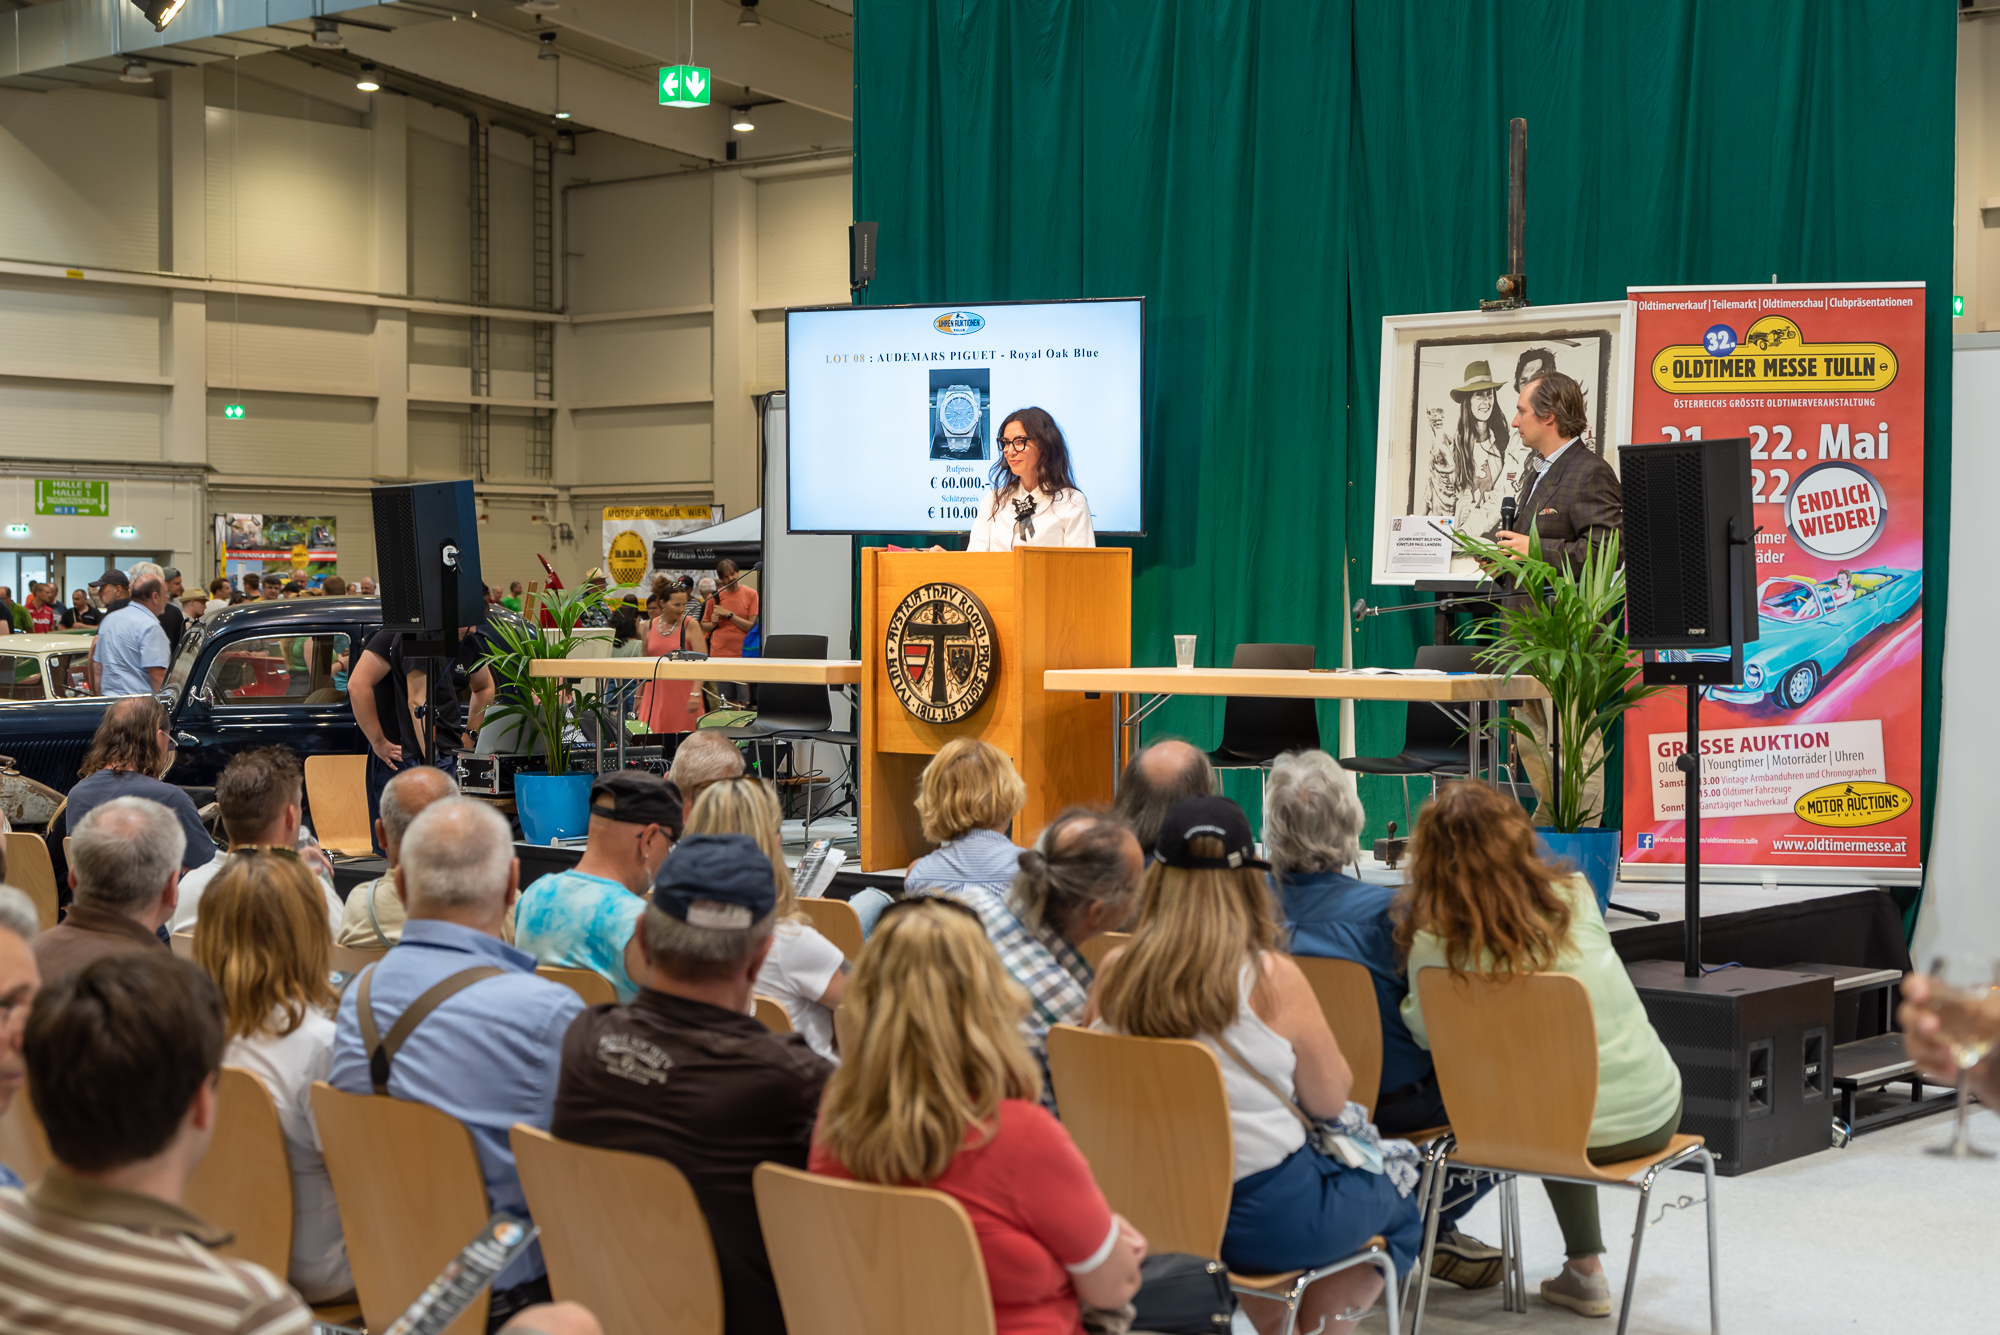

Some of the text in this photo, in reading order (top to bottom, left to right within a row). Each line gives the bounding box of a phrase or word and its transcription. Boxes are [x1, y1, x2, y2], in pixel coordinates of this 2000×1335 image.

[1638, 296, 1913, 311] Oldtimerverkauf Teilemarkt Oldtimerschau Clubpräsentationen
[1706, 330, 1736, 352] 32.
[825, 354, 850, 364] LOT
[853, 353, 865, 363] 08
[877, 351, 946, 363] AUDEMARS
[950, 350, 997, 361] PIGUET
[1009, 349, 1042, 362] Royal
[1046, 348, 1069, 359] Oak
[1073, 348, 1099, 358] Blue
[1672, 356, 1876, 379] OLDTIMER MESSE TULLN
[1673, 396, 1876, 409] ÖSTERREICHS GRÖSSTE OLDTIMERVERANSTALTUNG
[1818, 421, 1889, 460] Mai
[946, 465, 974, 474] Rufpreis
[52, 480, 83, 489] HALLE
[52, 489, 83, 497] HALLE
[941, 494, 979, 504] Schätzpreis
[1797, 483, 1871, 515] ENDLICH
[607, 508, 707, 518] MOTORSPORTCLUB WIEN
[940, 506, 978, 519] 110.00
[1798, 506, 1877, 538] WIEDER!
[1657, 731, 1830, 758] GRSSE AUKTION
[1707, 757, 1765, 771] Youngtimer
[1772, 752, 1827, 767] Motorräder
[1834, 750, 1864, 763] Uhren
[1720, 775, 1749, 785] Vintage
[1750, 771, 1805, 783] Armbanduhren
[1805, 770, 1820, 779] und
[1821, 767, 1877, 779] Chronographen
[1722, 787, 1754, 797] Oldtimer
[1755, 784, 1792, 795] Fahrzeuge
[1699, 800, 1742, 811] Ganztägiger
[1743, 796, 1788, 808] Nachverkauf
[1807, 794, 1899, 815] MOTOR AUCTIONS
[1772, 837, 1907, 853] www.oldtimermesse.at
